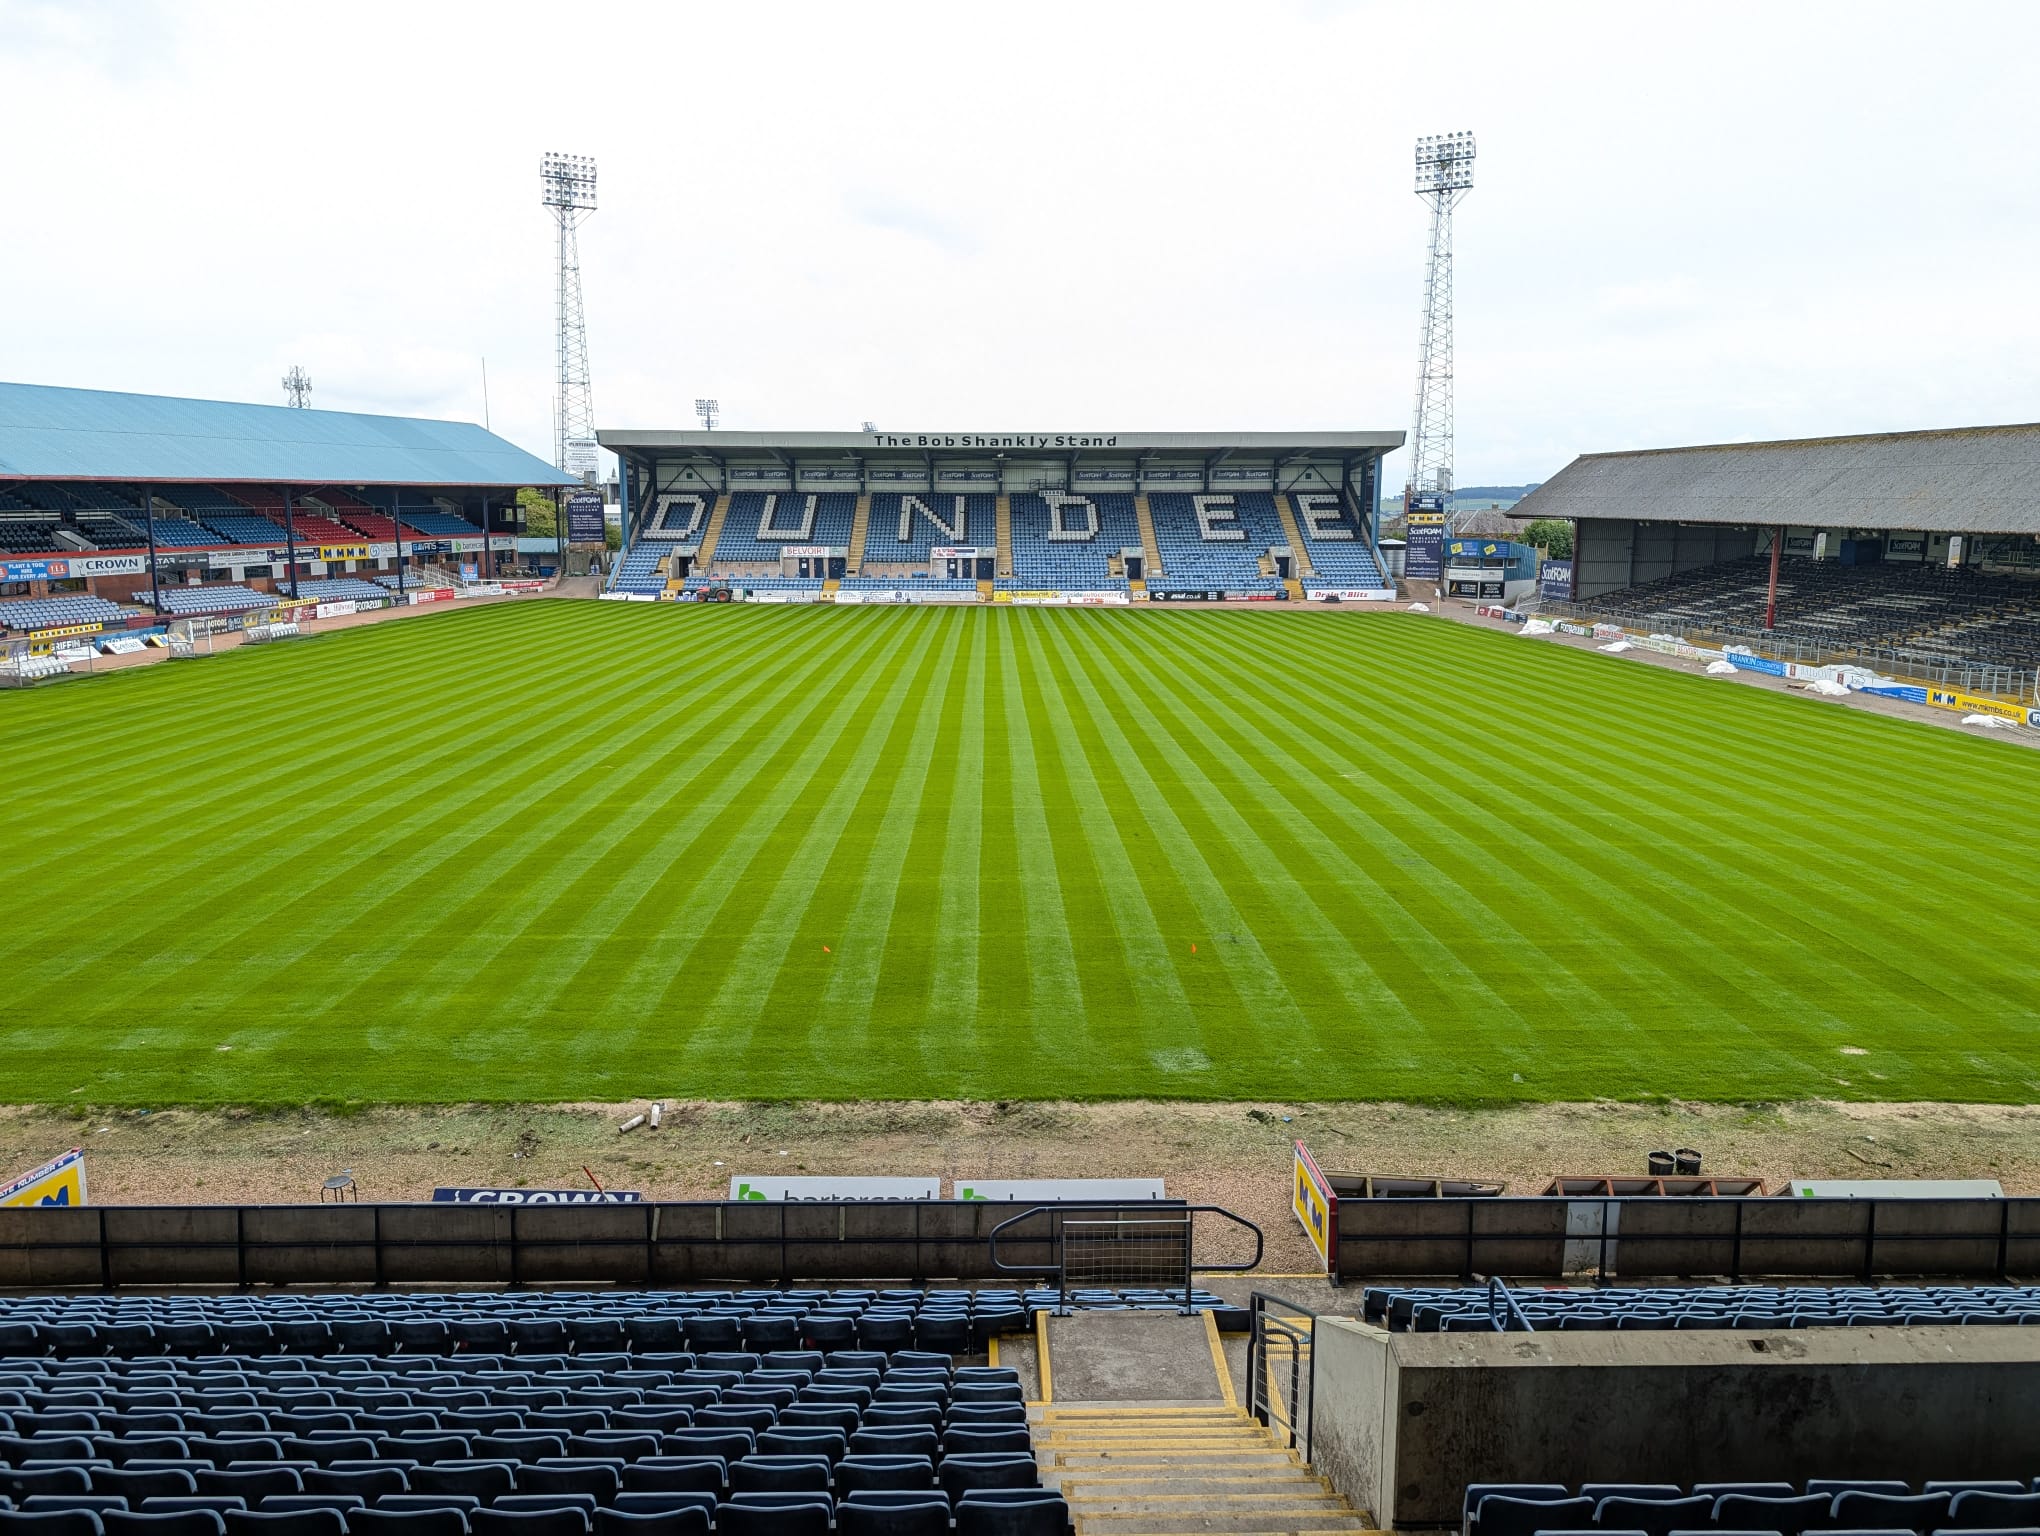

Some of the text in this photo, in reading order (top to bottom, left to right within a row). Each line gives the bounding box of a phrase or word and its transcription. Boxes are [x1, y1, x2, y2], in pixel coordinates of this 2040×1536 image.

[874, 435, 1117, 448] The Bob Shankly Stand
[86, 558, 138, 570] CROWN
[17, 1163, 56, 1189] NUMBER
